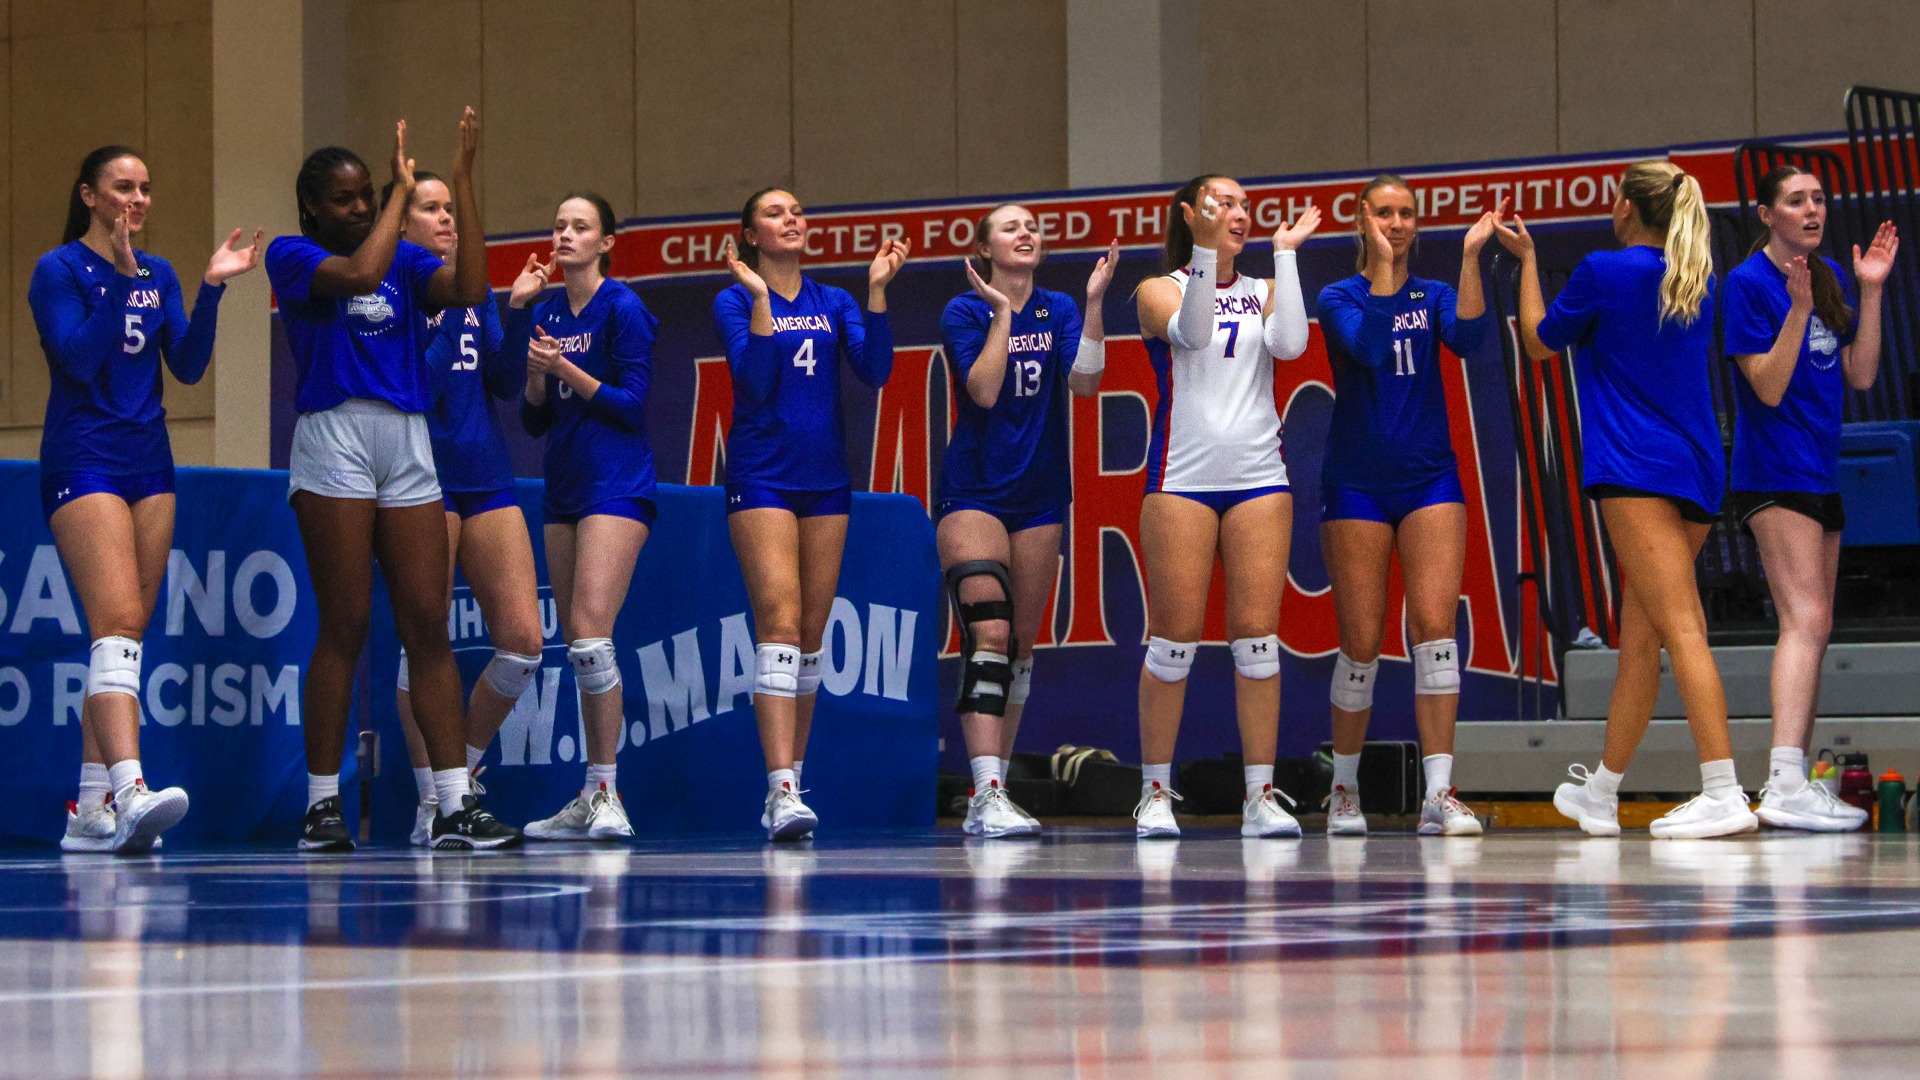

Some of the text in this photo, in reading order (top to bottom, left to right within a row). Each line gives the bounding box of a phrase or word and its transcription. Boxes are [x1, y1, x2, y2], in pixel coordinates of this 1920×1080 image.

[661, 173, 1620, 265] CHACTER FOED THGH CPETITION
[772, 313, 832, 334] AMERICAN
[1034, 308, 1049, 318] BG
[1215, 293, 1262, 316] ERICAN
[1392, 308, 1429, 333] RICAN
[123, 313, 146, 355] 5
[1217, 320, 1241, 359] 7
[792, 338, 818, 376] 4
[1393, 338, 1416, 376] 11
[1014, 360, 1042, 397] 13
[165, 549, 298, 639] NO
[53, 662, 301, 727] RCISM
